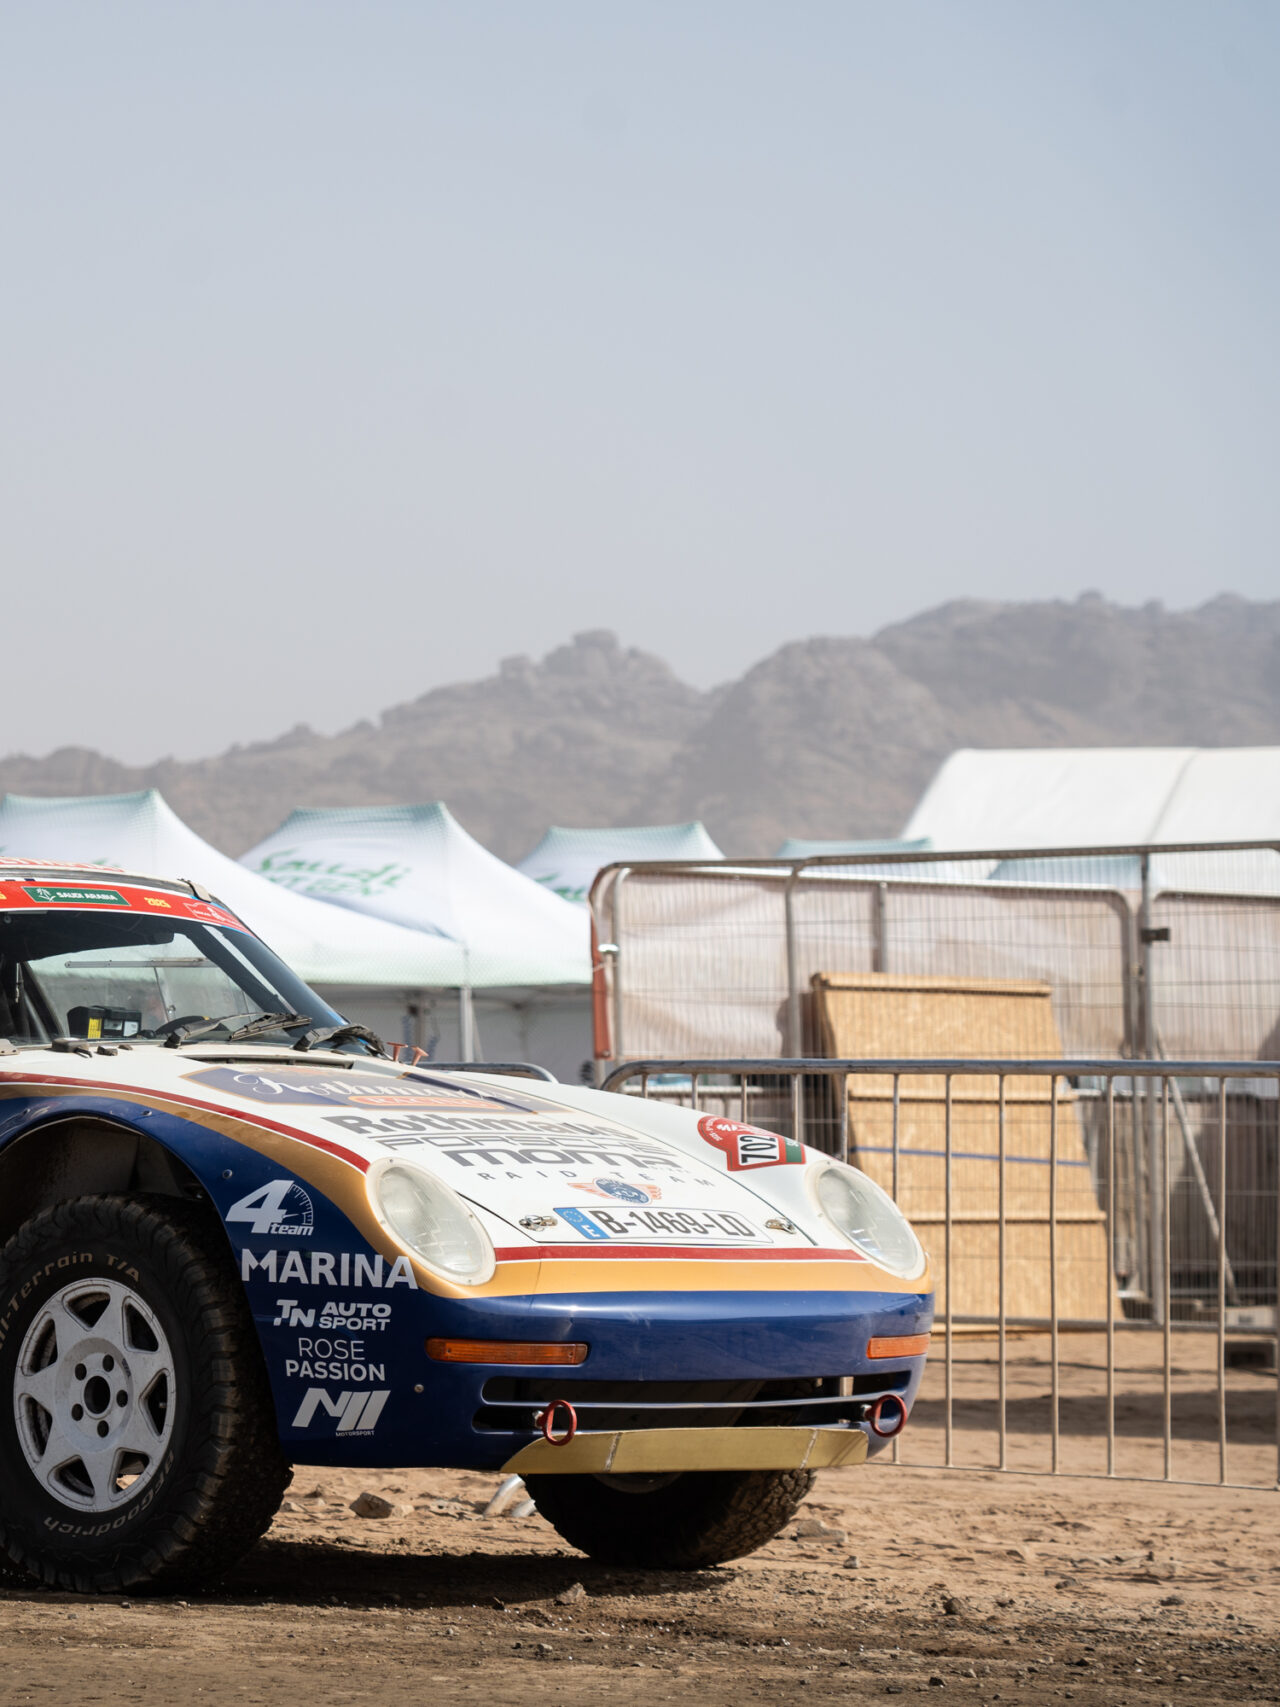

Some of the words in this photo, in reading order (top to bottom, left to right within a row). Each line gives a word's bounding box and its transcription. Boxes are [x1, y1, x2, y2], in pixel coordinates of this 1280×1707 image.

[56, 892, 83, 900] SAUDI
[83, 892, 118, 901] ARABIA
[740, 1135, 777, 1163] 702
[477, 1170, 577, 1181] RAID
[225, 1179, 295, 1234] 4
[270, 1222, 314, 1236] team
[581, 1225, 602, 1239] E
[589, 1209, 756, 1237] B-1469-LD
[105, 1254, 141, 1284] T/A
[241, 1248, 418, 1290] MARINA
[321, 1301, 392, 1317] AUTO
[318, 1317, 391, 1331] SPORT
[298, 1337, 366, 1360] ROSE
[285, 1359, 386, 1382] PASSION
